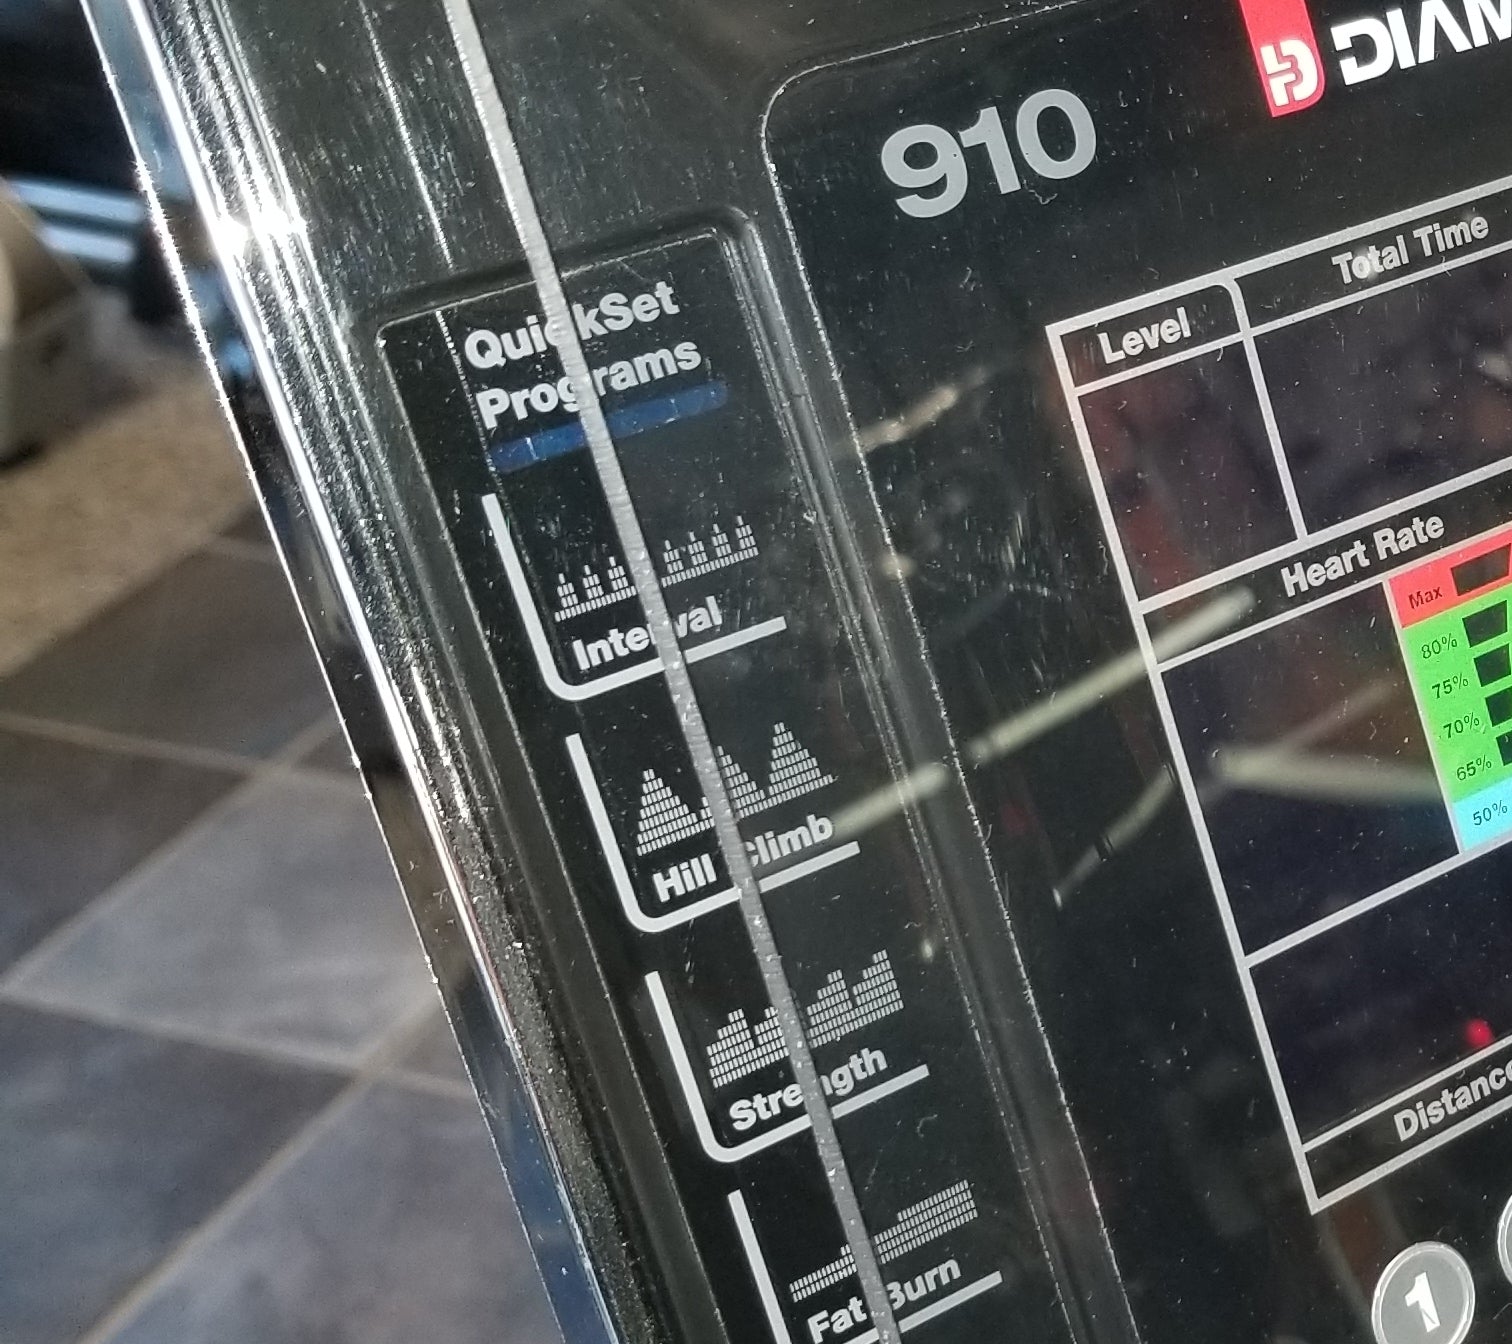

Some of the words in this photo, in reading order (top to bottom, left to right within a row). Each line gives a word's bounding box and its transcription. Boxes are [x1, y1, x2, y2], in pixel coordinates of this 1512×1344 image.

[879, 87, 1098, 219] 910
[1332, 229, 1408, 286] Total
[1412, 210, 1490, 260] Time
[465, 280, 681, 370] QuickSet
[1098, 308, 1192, 367] Level
[475, 341, 702, 431] Programs
[1279, 540, 1369, 599] Heart
[1372, 510, 1447, 566] Rate
[1408, 585, 1444, 611] Max
[1420, 632, 1459, 660] 80%
[1431, 671, 1470, 700] 75%
[1442, 711, 1481, 740] 70%
[1455, 754, 1493, 782] 65%
[1471, 798, 1509, 827] 50%
[651, 852, 718, 904] Hill
[1404, 1271, 1441, 1334] 1
